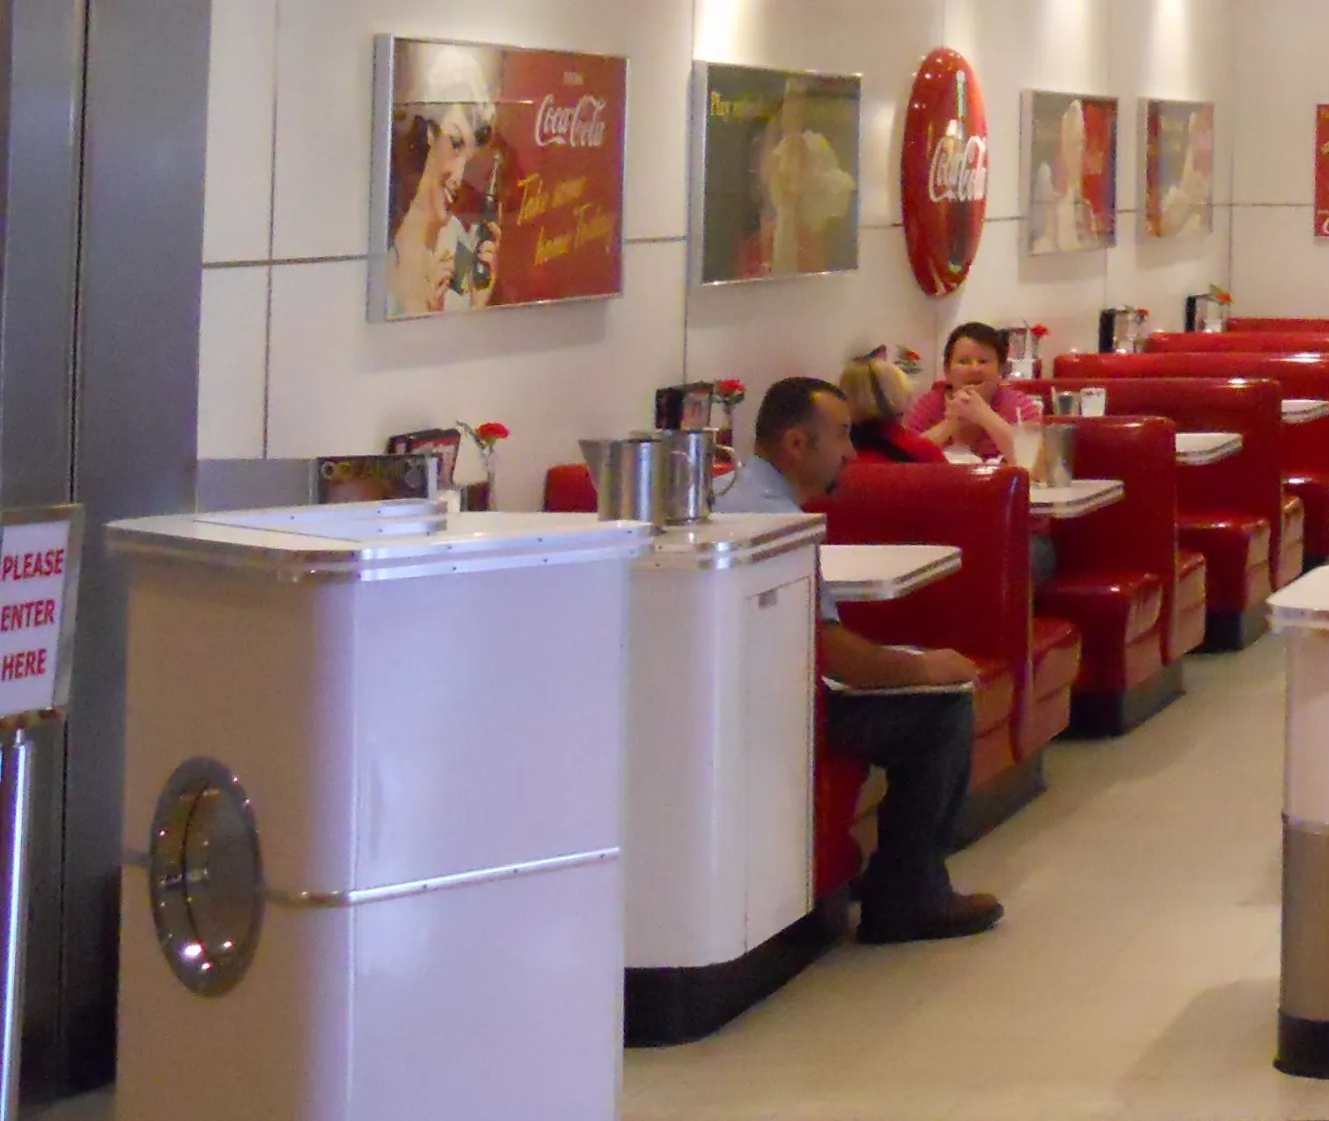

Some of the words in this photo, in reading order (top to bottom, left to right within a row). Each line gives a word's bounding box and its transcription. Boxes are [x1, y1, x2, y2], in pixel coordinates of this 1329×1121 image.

[2, 548, 65, 581] PLEASE
[0, 598, 56, 631] ENTER
[2, 648, 48, 682] HERE
